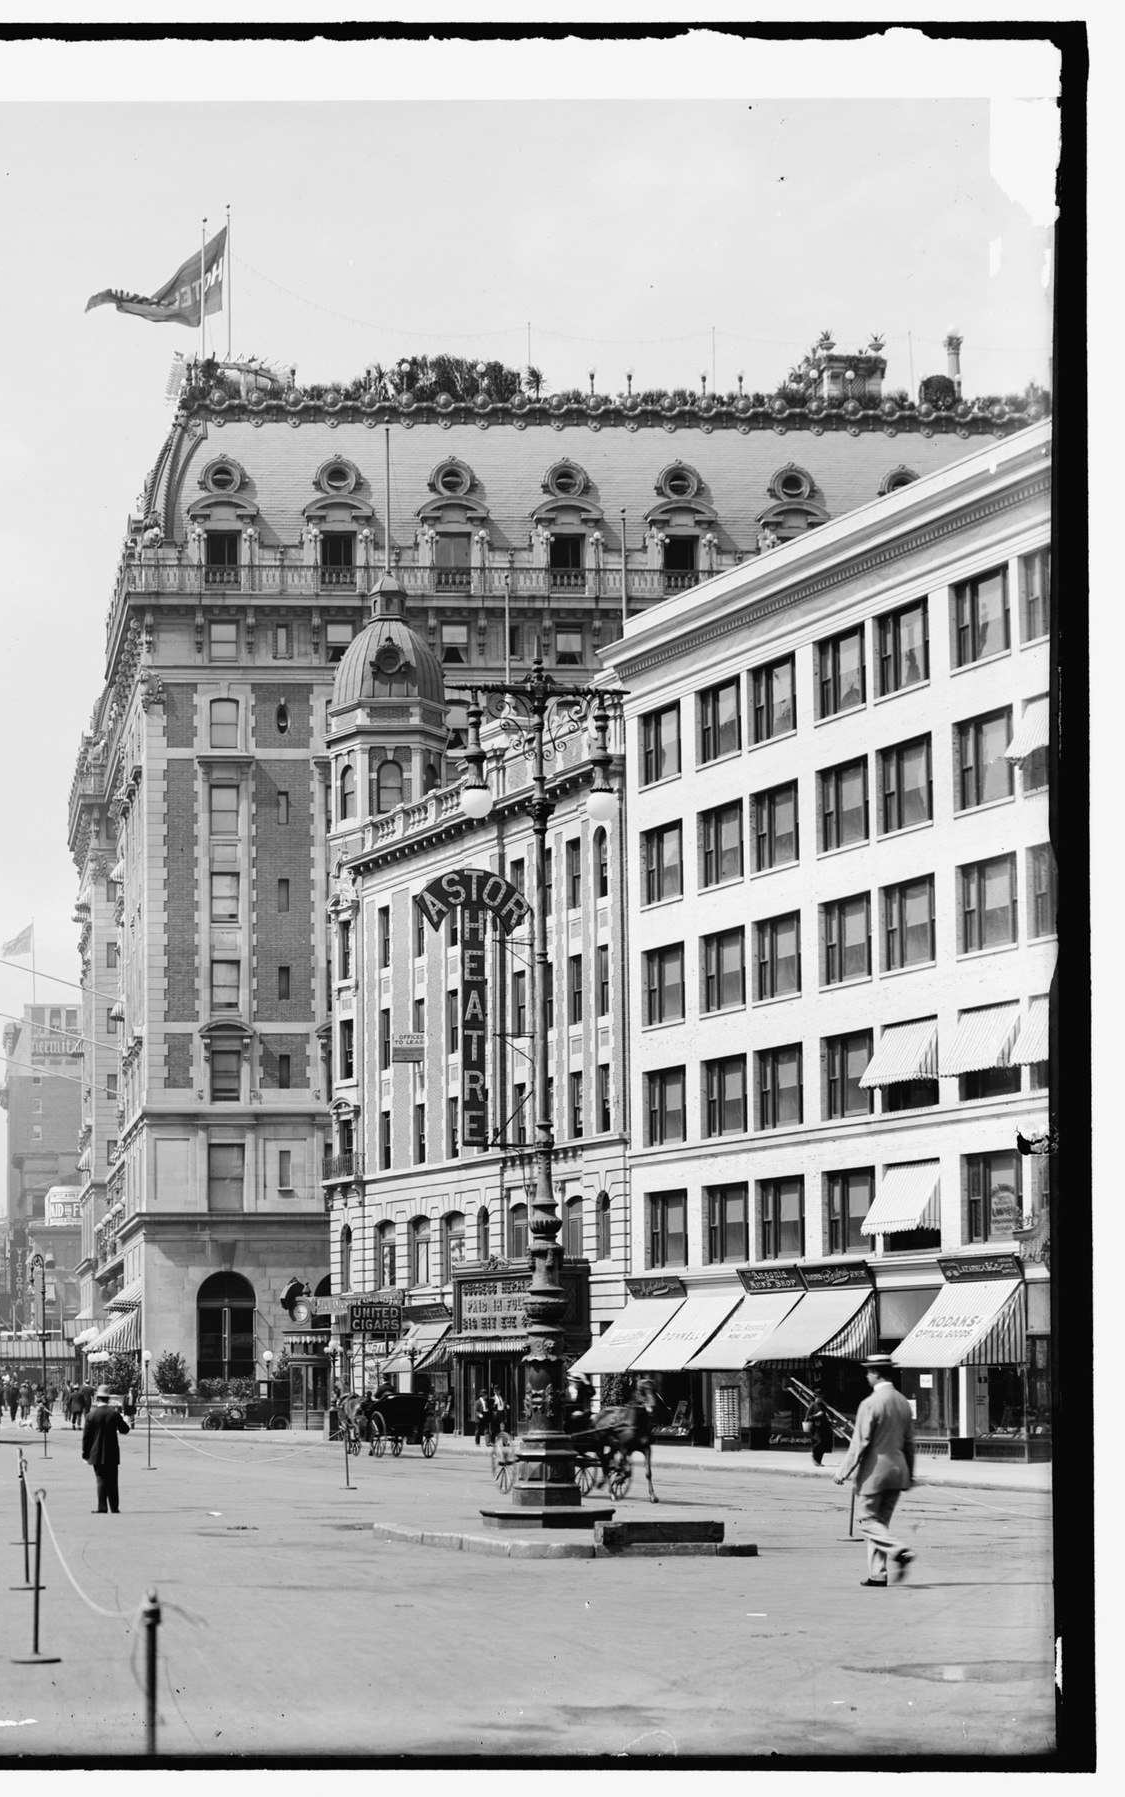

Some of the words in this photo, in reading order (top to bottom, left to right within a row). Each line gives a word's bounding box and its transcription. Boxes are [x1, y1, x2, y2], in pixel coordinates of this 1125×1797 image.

[421, 869, 527, 927] ASTOR
[15, 1247, 24, 1305] VICTORIA
[353, 1307, 399, 1318] UNITED
[352, 1319, 400, 1330] CIGARS
[927, 1315, 979, 1328] KODAKS
